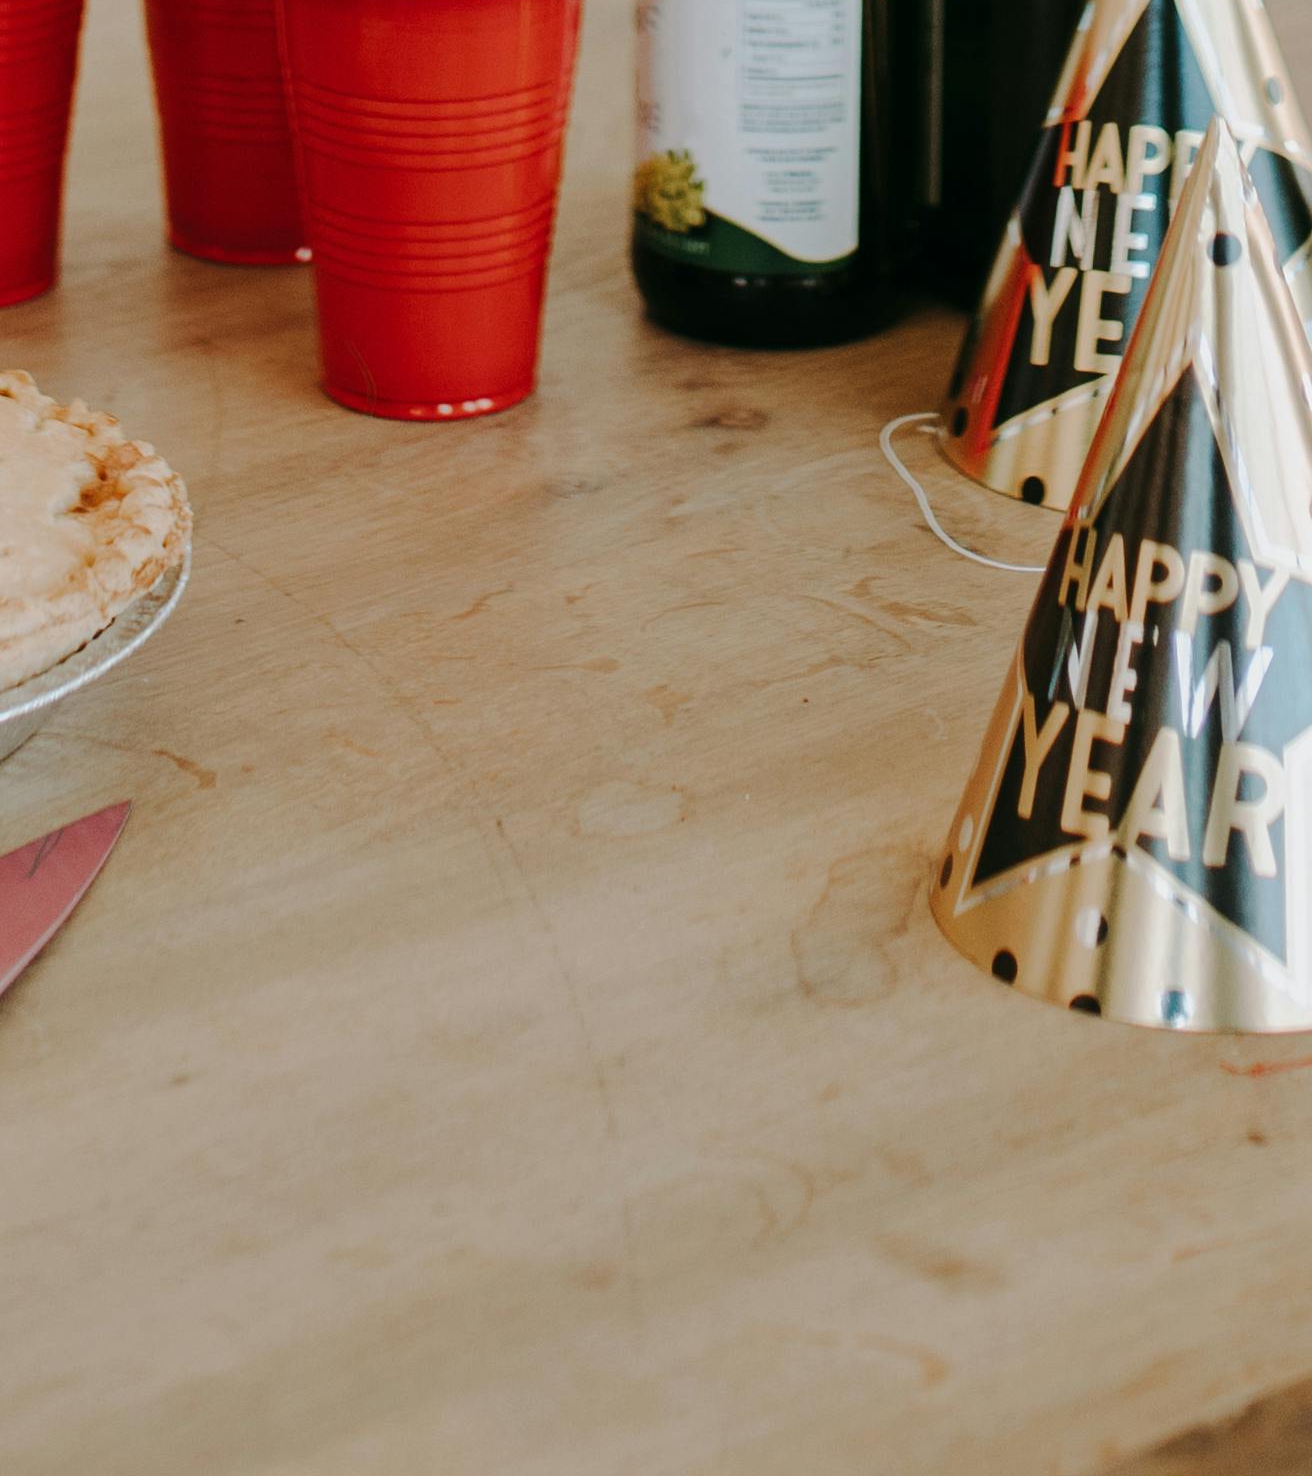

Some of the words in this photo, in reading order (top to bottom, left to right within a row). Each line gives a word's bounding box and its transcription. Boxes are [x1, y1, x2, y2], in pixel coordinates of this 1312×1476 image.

[1054, 120, 1257, 206] HAPP
[1049, 184, 1157, 279] NE
[1024, 263, 1134, 375] YE
[1057, 521, 1290, 651] HAPPY
[1047, 606, 1274, 741] NEW
[1016, 691, 1286, 878] YEAR
